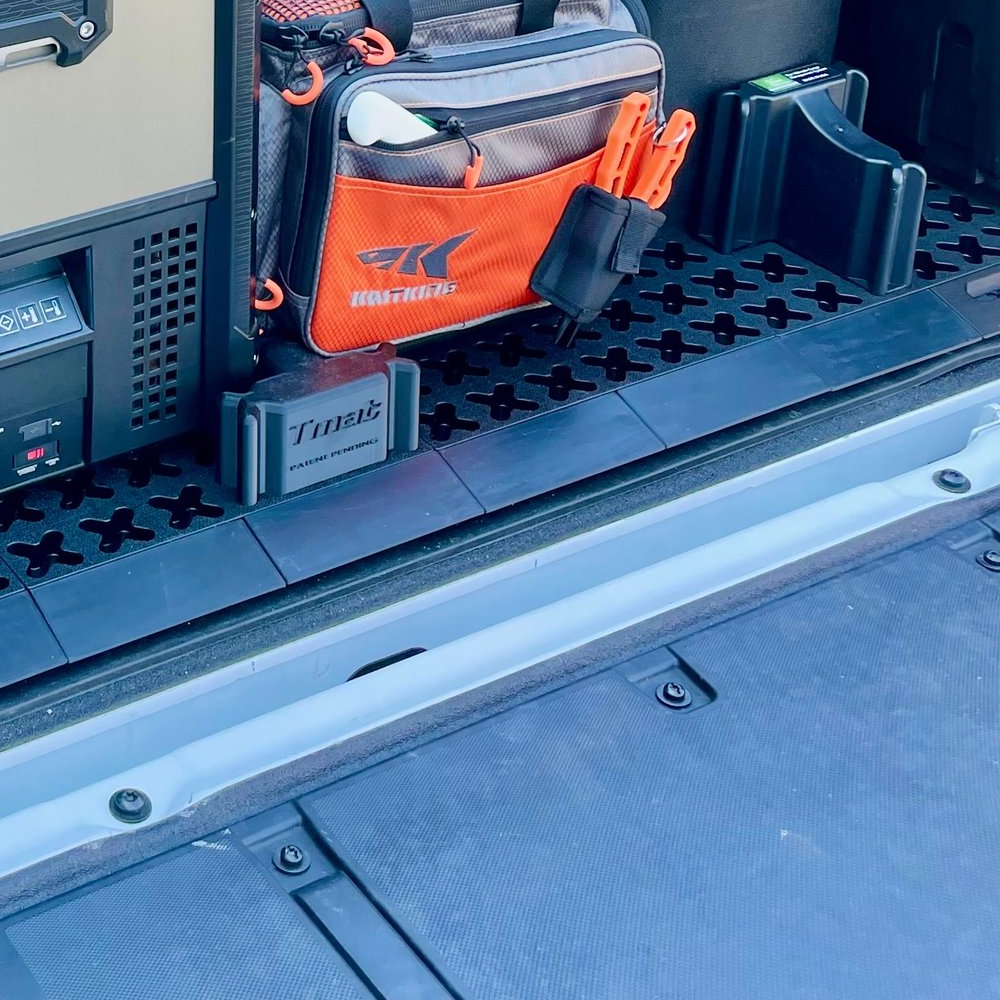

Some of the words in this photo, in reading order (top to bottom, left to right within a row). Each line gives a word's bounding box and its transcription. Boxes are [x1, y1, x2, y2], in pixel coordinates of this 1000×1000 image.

[288, 399, 382, 447] Tmat
[289, 454, 328, 472] PATENT
[330, 437, 379, 458] PENDING
